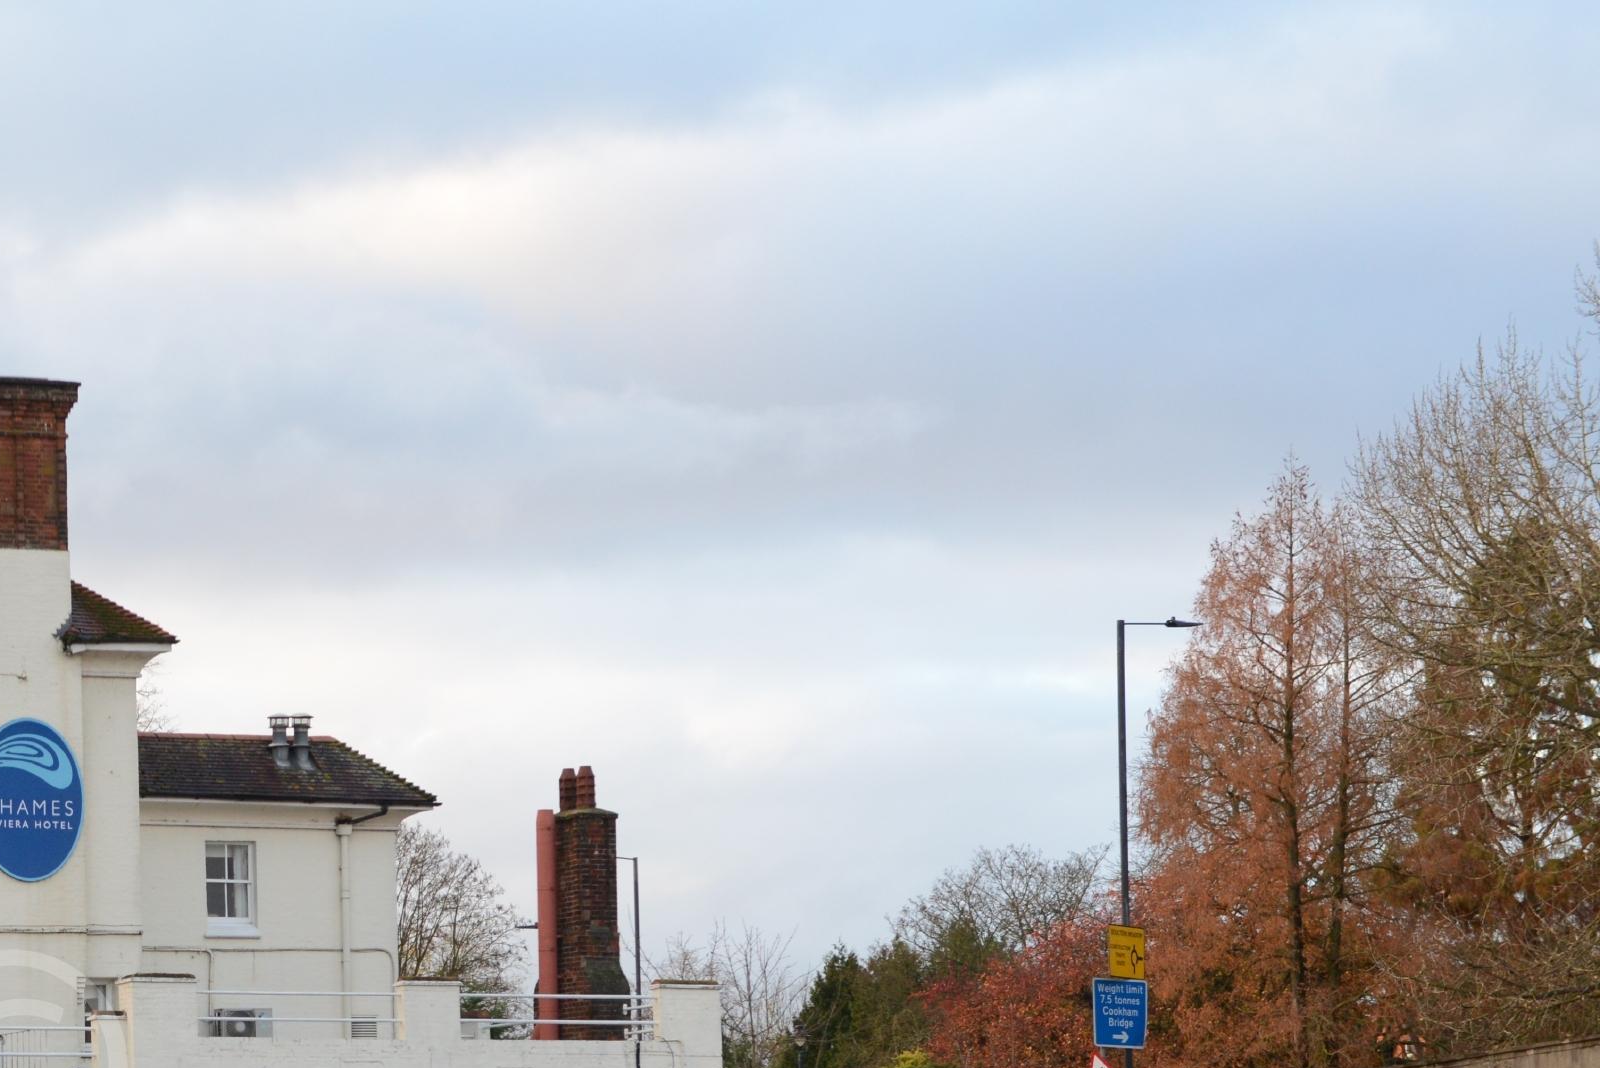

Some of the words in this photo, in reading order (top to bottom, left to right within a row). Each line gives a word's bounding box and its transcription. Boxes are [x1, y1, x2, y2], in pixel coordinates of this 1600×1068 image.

[34, 820, 73, 830] HOTEL
[1097, 983, 1124, 995] Weight
[1125, 984, 1143, 995] limit
[1100, 994, 1112, 1005] 7.5
[1114, 995, 1140, 1006] tonnes
[1102, 1006, 1138, 1017] Cookham
[1108, 1017, 1134, 1029] Bridge
